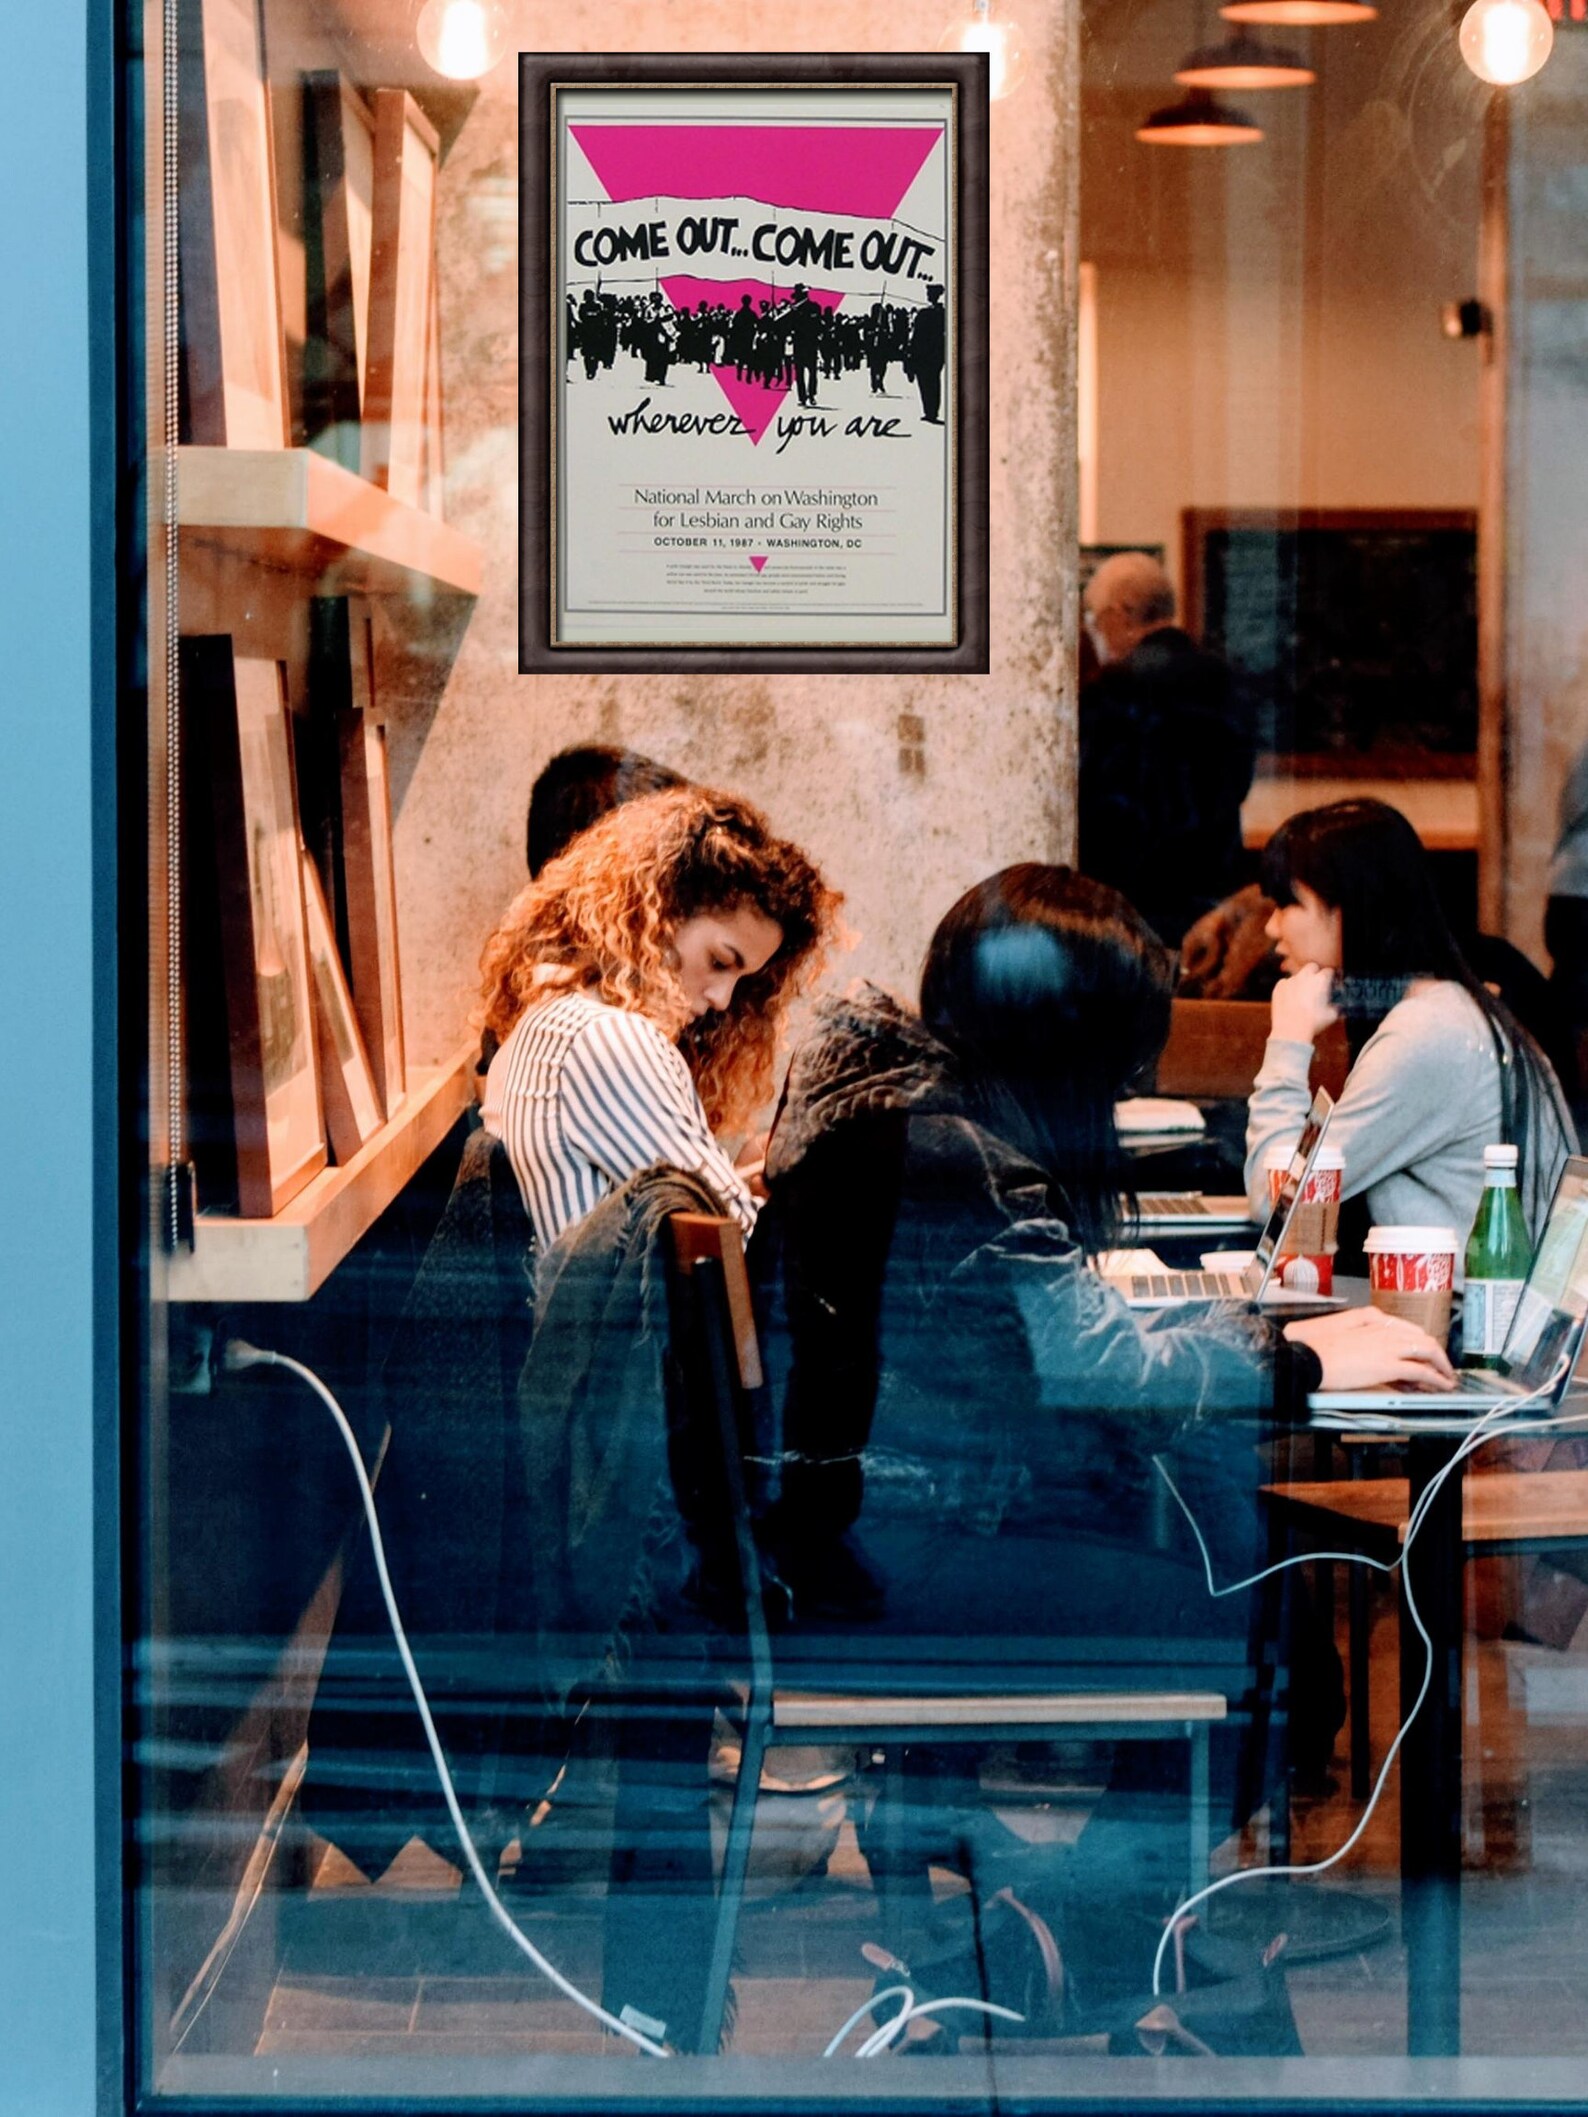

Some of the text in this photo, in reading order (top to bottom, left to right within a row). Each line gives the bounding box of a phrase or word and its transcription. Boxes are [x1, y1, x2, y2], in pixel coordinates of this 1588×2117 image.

[575, 221, 669, 267] COME
[752, 224, 854, 270] COME
[608, 398, 912, 454] wherever you are
[634, 488, 878, 509] National March on Washington
[653, 511, 863, 533] for Lesbian and Gay Rights
[654, 537, 862, 549] OCTOBER 11, 1987 WASHINGTON, DC
